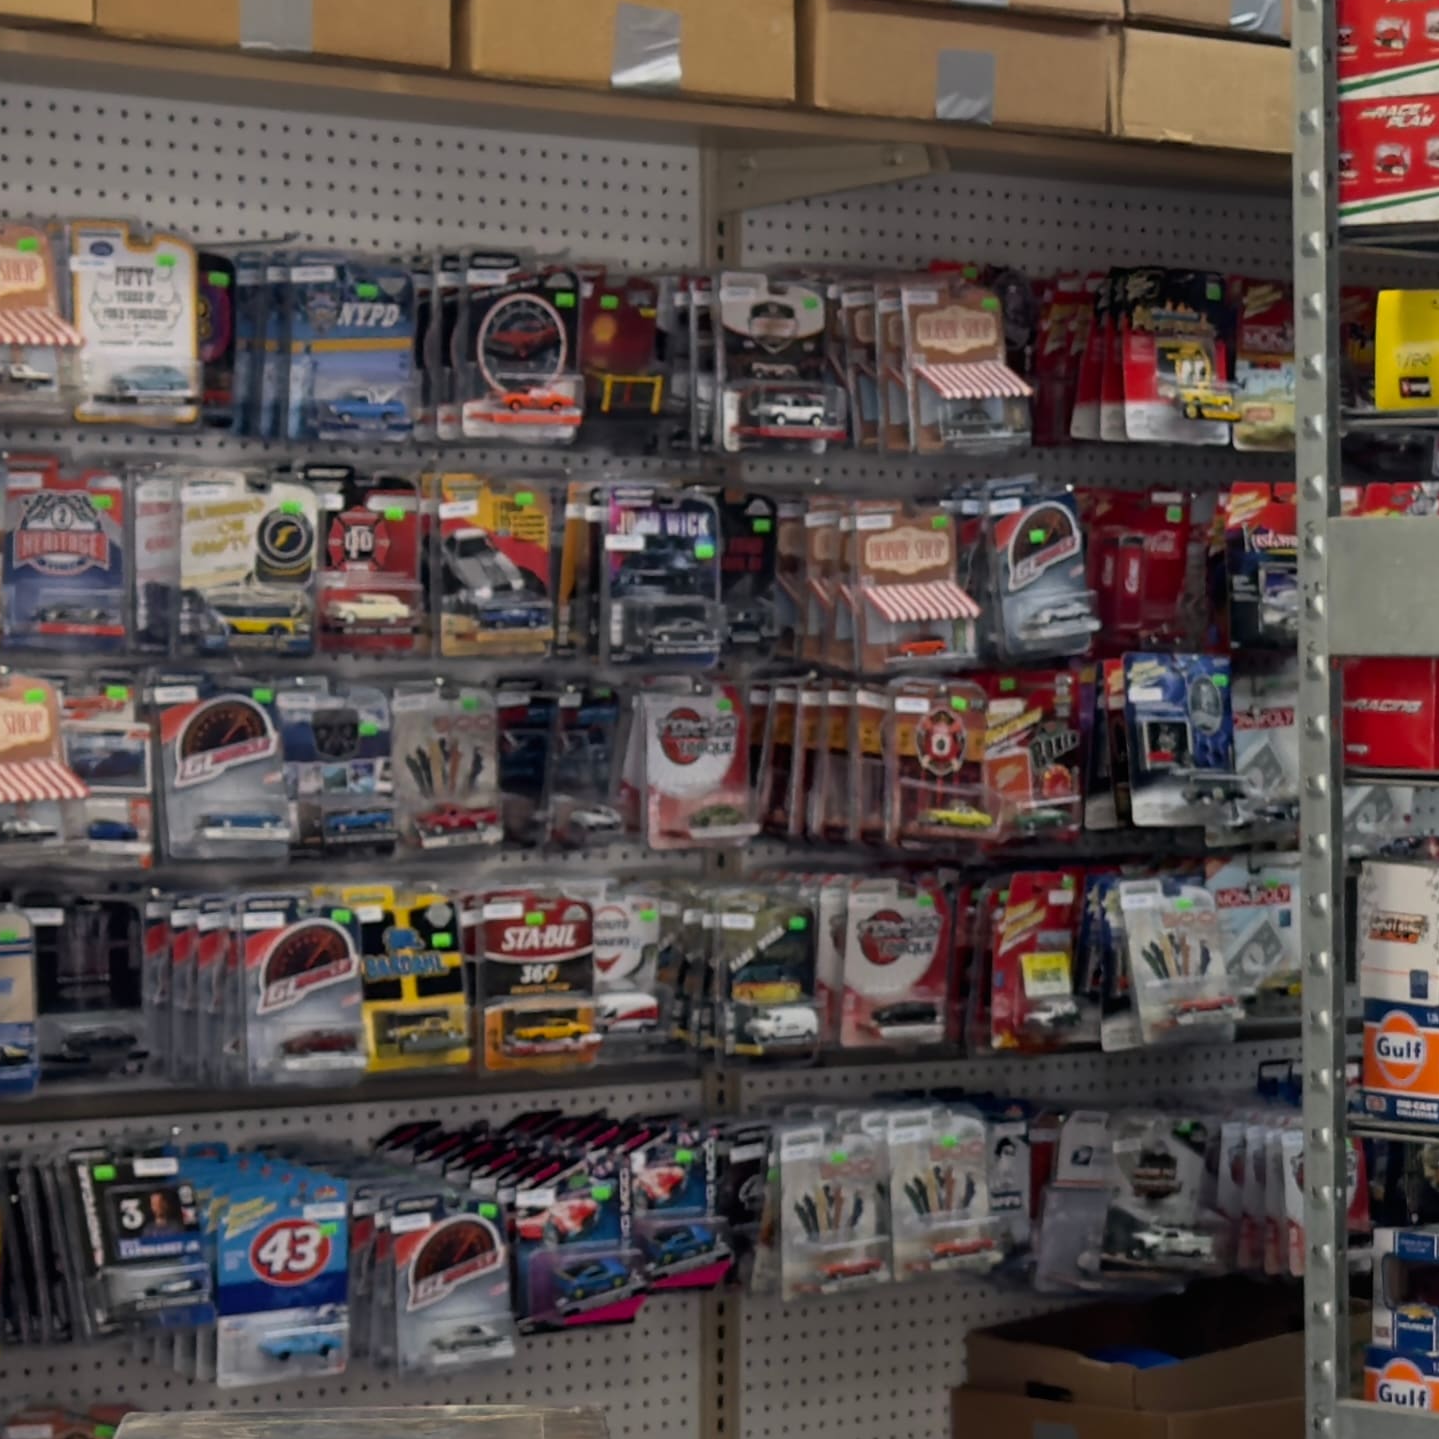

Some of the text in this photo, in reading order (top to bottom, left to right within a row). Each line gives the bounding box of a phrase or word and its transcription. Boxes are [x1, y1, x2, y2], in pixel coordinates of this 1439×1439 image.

[336, 302, 401, 329] NYPD
[666, 511, 710, 536] WICK
[19, 532, 102, 557] HERITAGE
[1354, 698, 1423, 714] RACING
[364, 952, 449, 980] BARDAHL
[520, 964, 558, 985] 360
[1374, 1035, 1425, 1063] Gulf
[120, 1199, 143, 1230] 3
[258, 1226, 322, 1274] 43
[1378, 1383, 1428, 1411] Gulf
